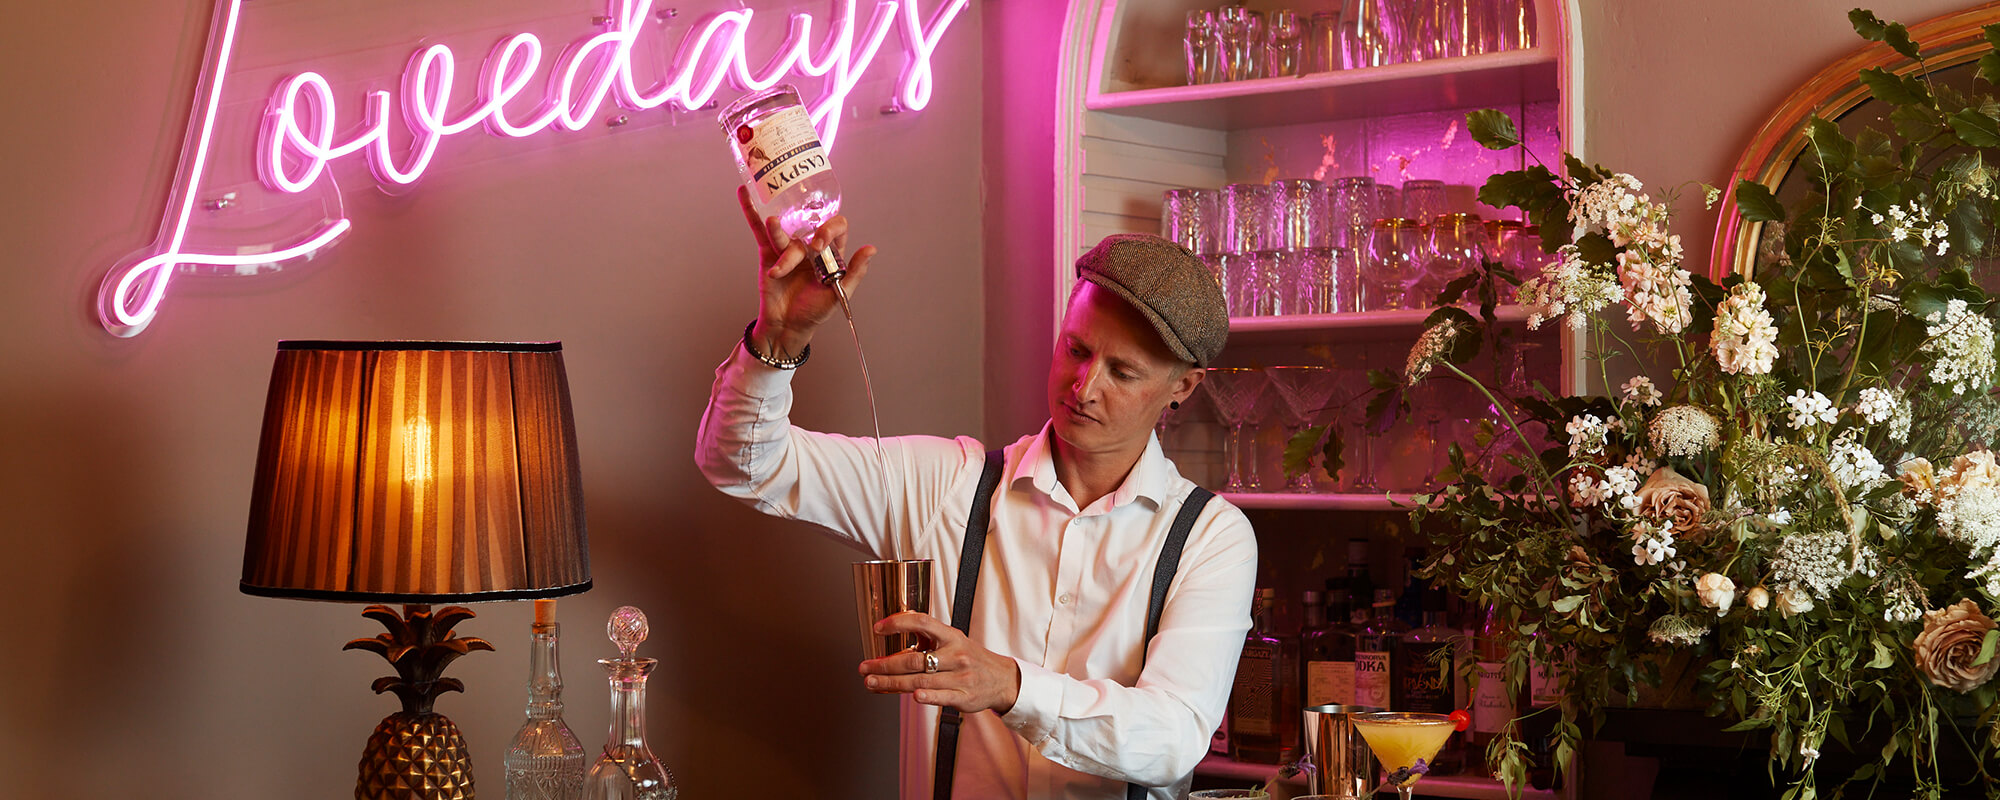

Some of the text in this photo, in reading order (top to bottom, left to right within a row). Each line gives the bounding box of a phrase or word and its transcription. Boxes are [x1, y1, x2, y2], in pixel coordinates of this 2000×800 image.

[112, 0, 970, 327] Lovedays
[766, 154, 825, 194] CASPYN
[1355, 660, 1386, 672] ODKA
